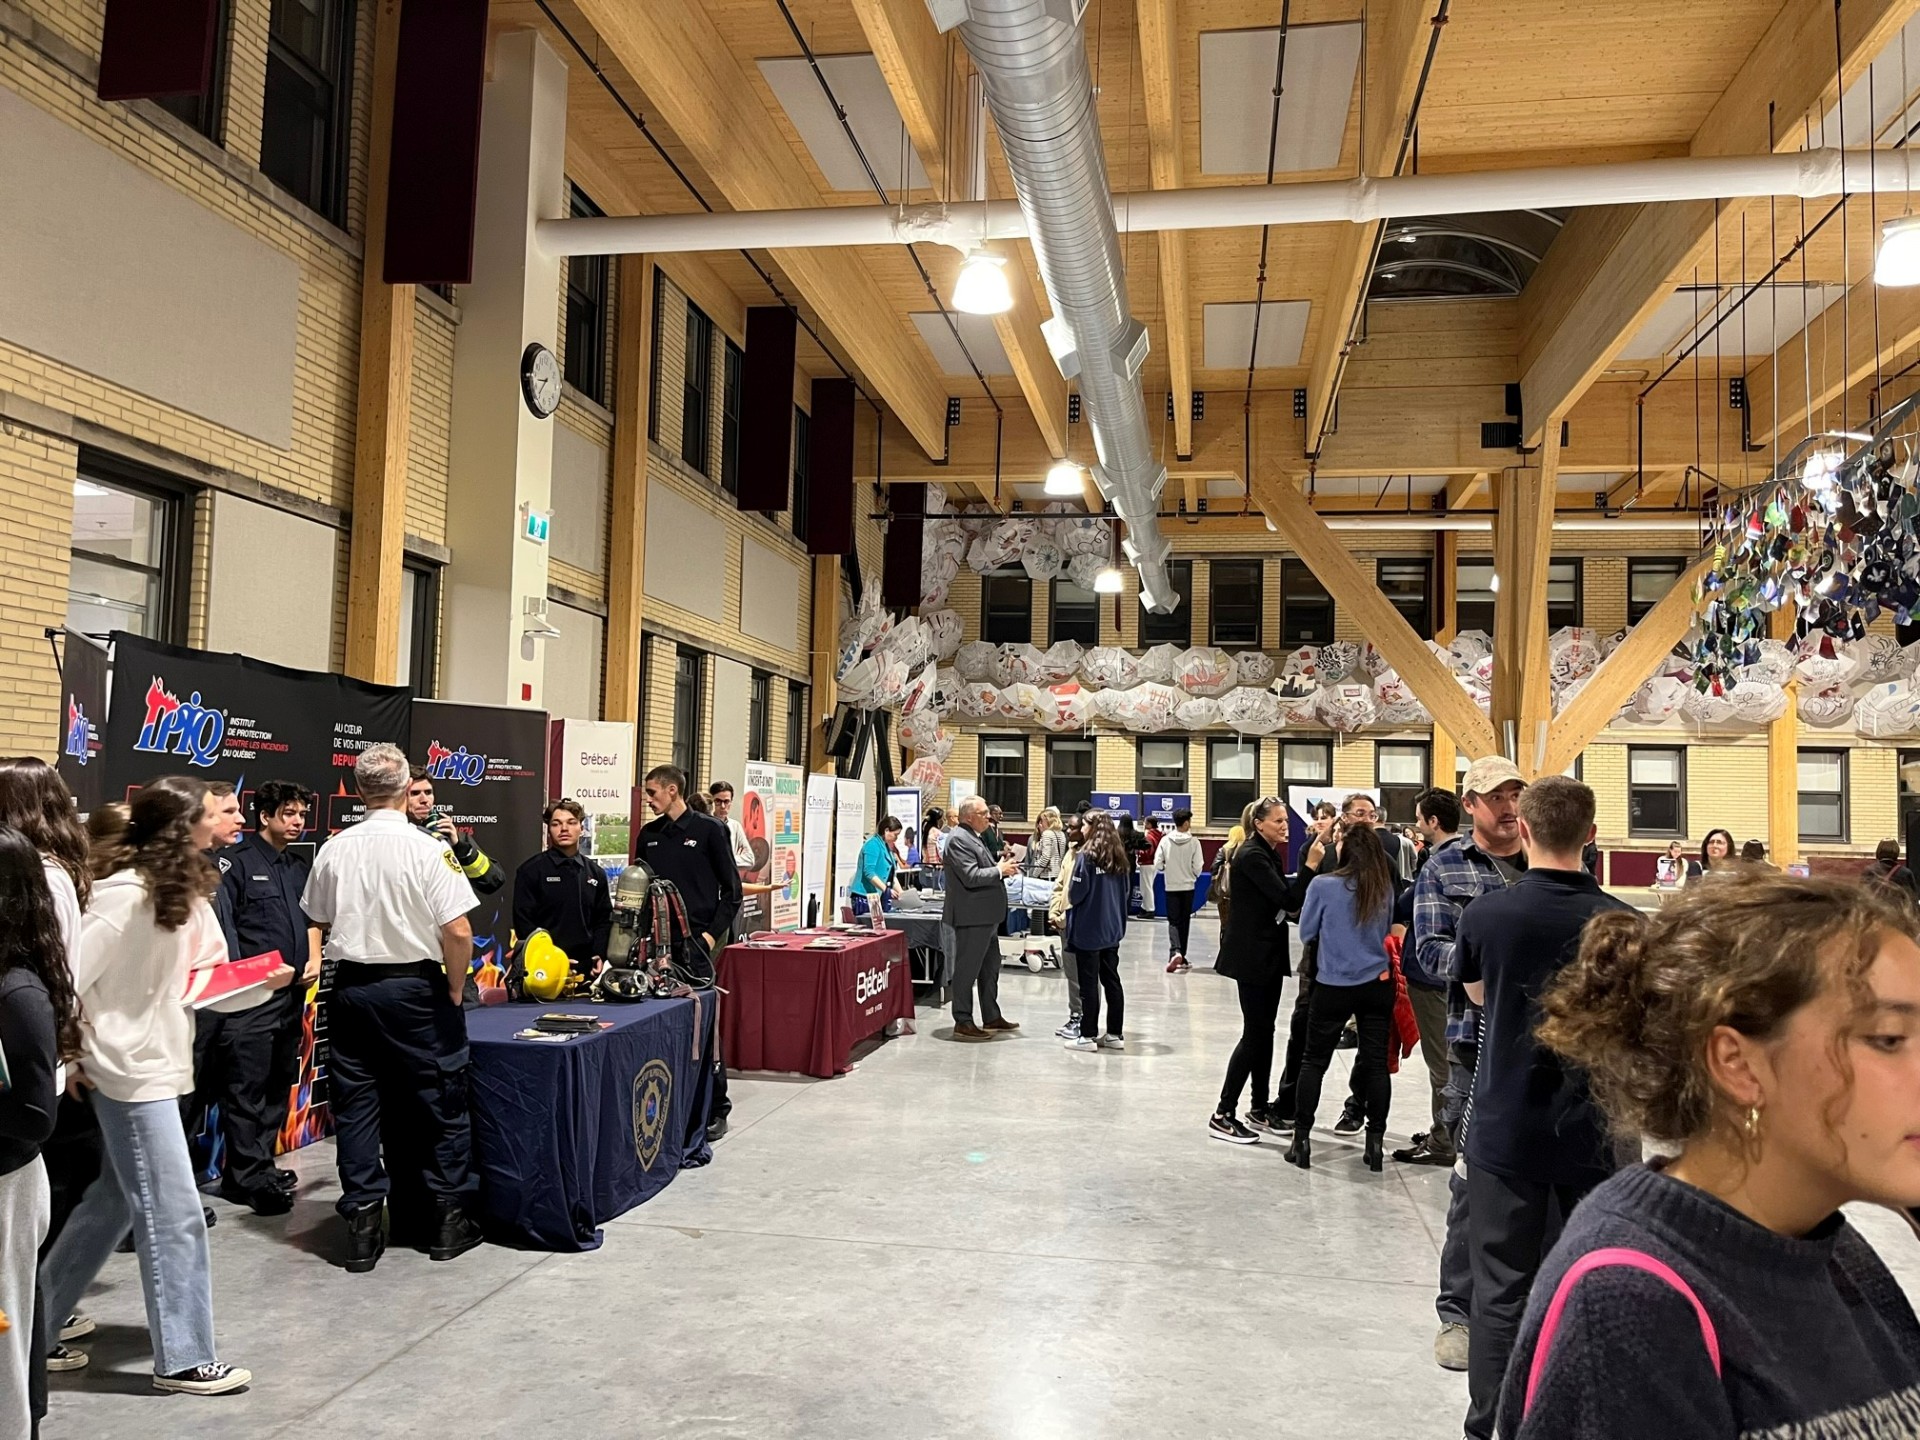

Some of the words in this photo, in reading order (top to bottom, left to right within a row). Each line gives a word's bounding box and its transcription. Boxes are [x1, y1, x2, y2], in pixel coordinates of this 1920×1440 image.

[229, 716, 256, 728] INSTITUT
[333, 722, 344, 734] AU
[227, 727, 236, 736] DE
[236, 728, 273, 740] PROTECTION
[225, 738, 249, 748] CONTRE
[249, 739, 260, 750] LES
[260, 741, 289, 752] INCENDIES
[333, 737, 344, 749] DE
[344, 738, 355, 750] VOS
[222, 749, 232, 758] DU
[232, 748, 257, 760] QUÉBEC
[580, 752, 617, 767] Brébeuf
[576, 786, 620, 799] COLLÉGIAL
